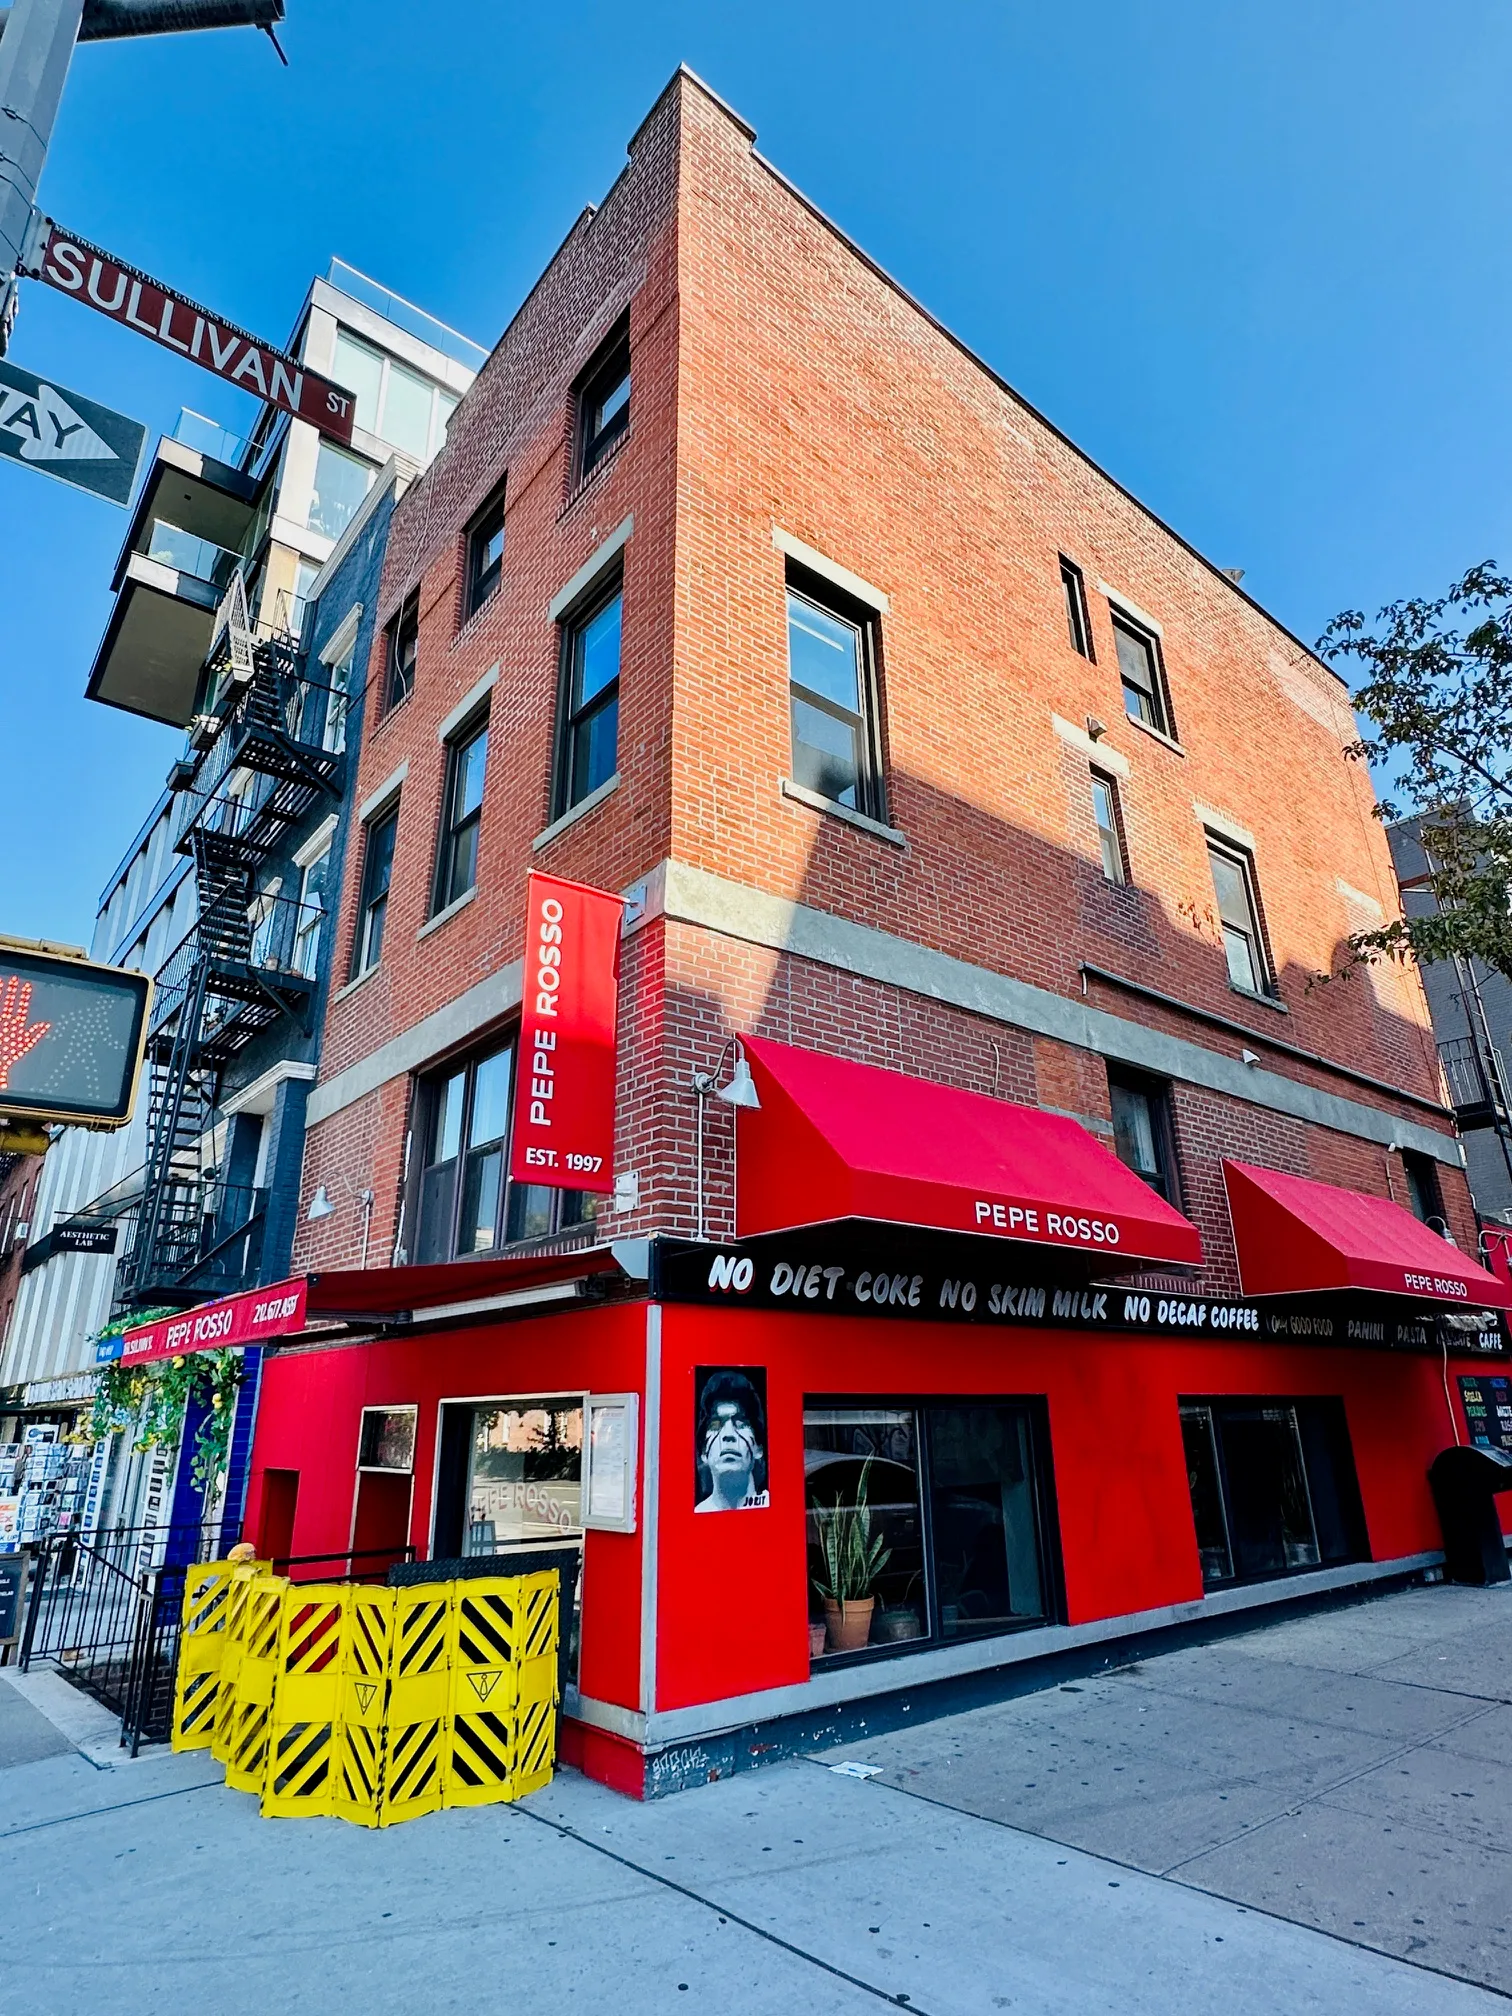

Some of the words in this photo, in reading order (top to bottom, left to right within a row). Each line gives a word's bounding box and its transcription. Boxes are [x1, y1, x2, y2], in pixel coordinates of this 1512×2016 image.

[46, 241, 304, 412] SULLIVAN
[326, 391, 350, 418] ST
[174, 291, 220, 322] GARDENS
[222, 318, 266, 347] HISTORIC
[0, 390, 85, 450] AY
[536, 898, 564, 1018] ROSSO
[529, 1028, 557, 1126] PEPE
[525, 1146, 560, 1168] EST.
[565, 1153, 603, 1173] 1997
[60, 1230, 110, 1241] AESTHETIC
[75, 1239, 94, 1247] LAB
[974, 1201, 1040, 1233] PEPE
[1046, 1212, 1120, 1245] ROSSO
[708, 1254, 755, 1294] NO
[769, 1262, 845, 1300] DIET
[855, 1270, 924, 1307] COKE
[939, 1278, 977, 1312] NO
[988, 1284, 1046, 1318] SKIM
[1052, 1289, 1108, 1320] MILK
[1124, 1295, 1151, 1323] NO
[1157, 1299, 1206, 1327] DECAF
[1210, 1305, 1260, 1331] COFFEE
[1290, 1316, 1312, 1335] GOOD
[1313, 1317, 1334, 1337] FOOD
[1348, 1320, 1384, 1341] PANINI
[1397, 1325, 1427, 1345] PASTA
[1478, 1332, 1503, 1351] CAFFE
[1404, 1273, 1433, 1291] PEPE
[1434, 1278, 1468, 1297] ROSSO
[513, 1482, 572, 1535] ROSSO
[743, 1495, 767, 1507] JORIT
